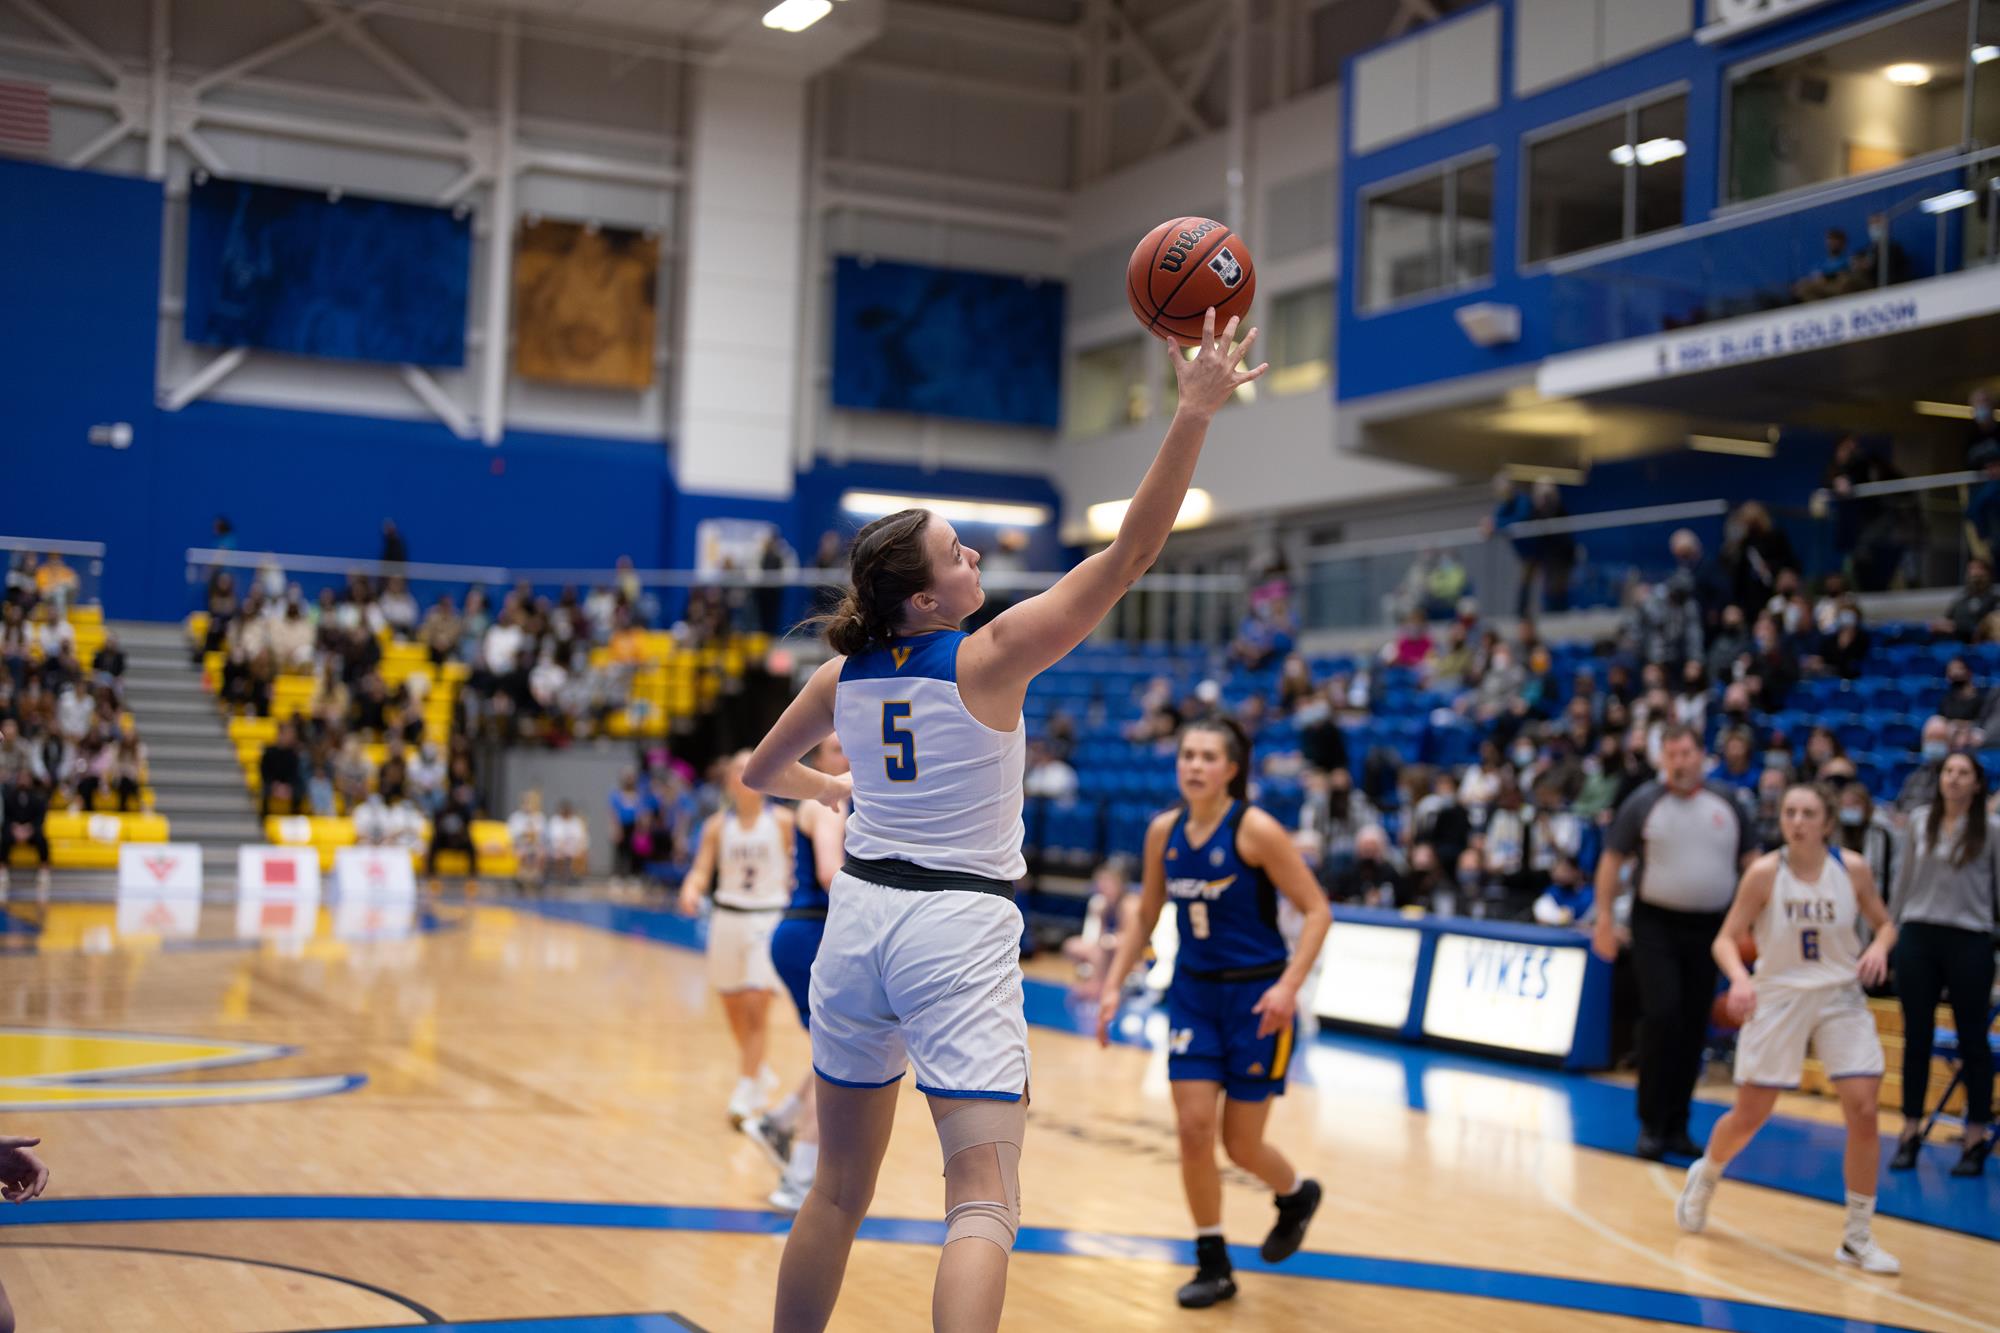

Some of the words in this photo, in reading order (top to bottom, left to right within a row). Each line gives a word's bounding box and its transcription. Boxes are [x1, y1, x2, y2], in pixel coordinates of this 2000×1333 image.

[1160, 220, 1221, 273] Wilson
[883, 701, 918, 782] 5
[1784, 898, 1836, 924] VIKES
[1464, 941, 1554, 1000] VIKES
[1800, 928, 1822, 962] 6
